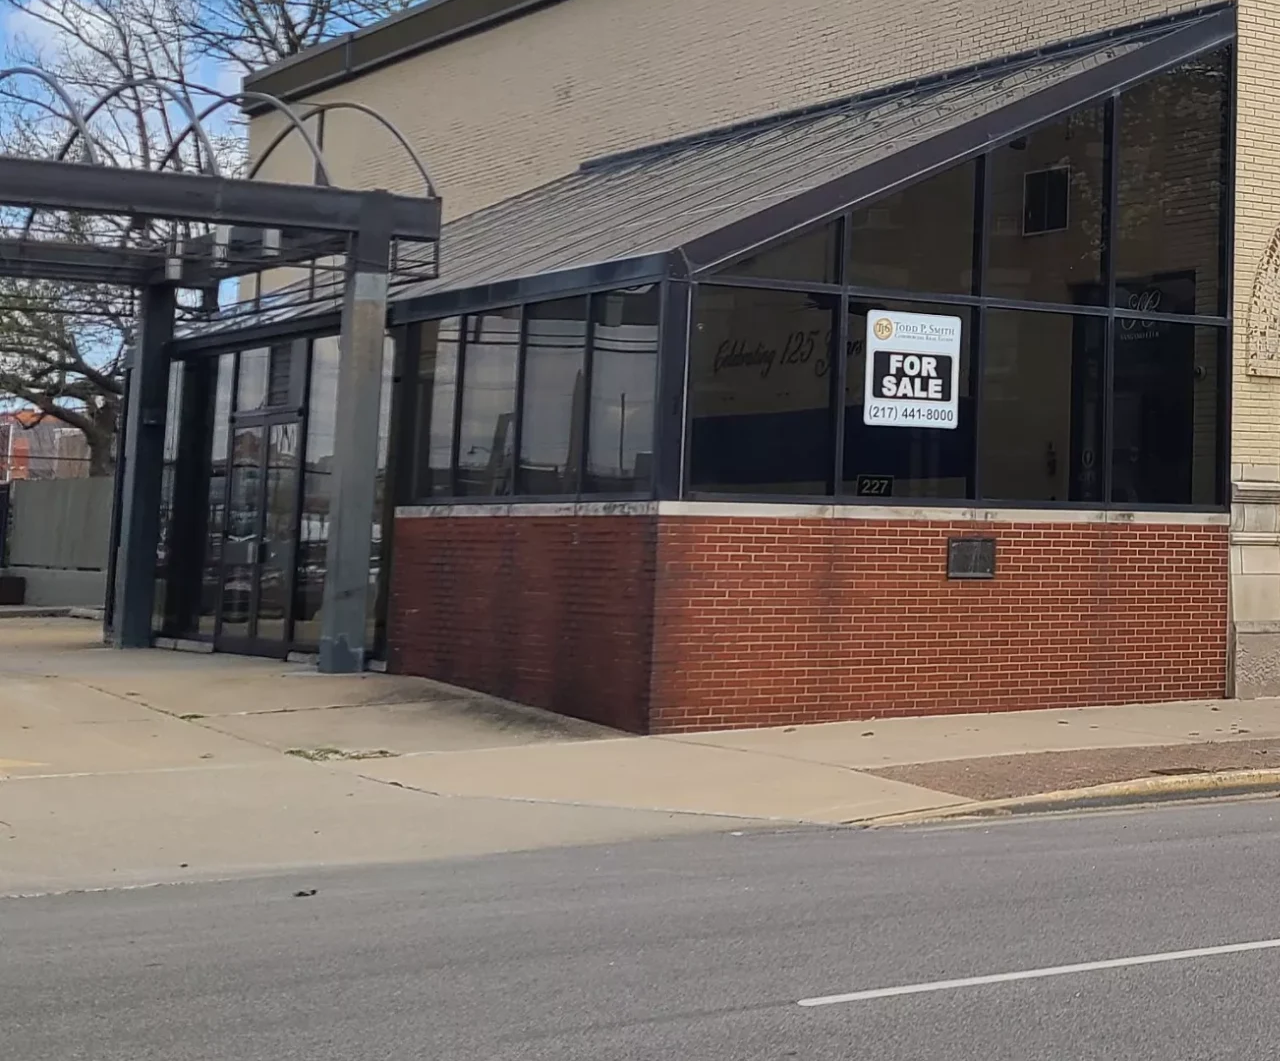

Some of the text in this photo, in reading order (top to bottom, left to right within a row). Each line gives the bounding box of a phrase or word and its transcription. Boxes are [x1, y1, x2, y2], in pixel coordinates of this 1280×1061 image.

[928, 324, 955, 336] SMITH
[779, 330, 820, 365] 125
[889, 354, 938, 377] FOR
[881, 375, 943, 399] SALE
[868, 404, 954, 422] (217) 441-8000
[861, 479, 889, 494] 227
